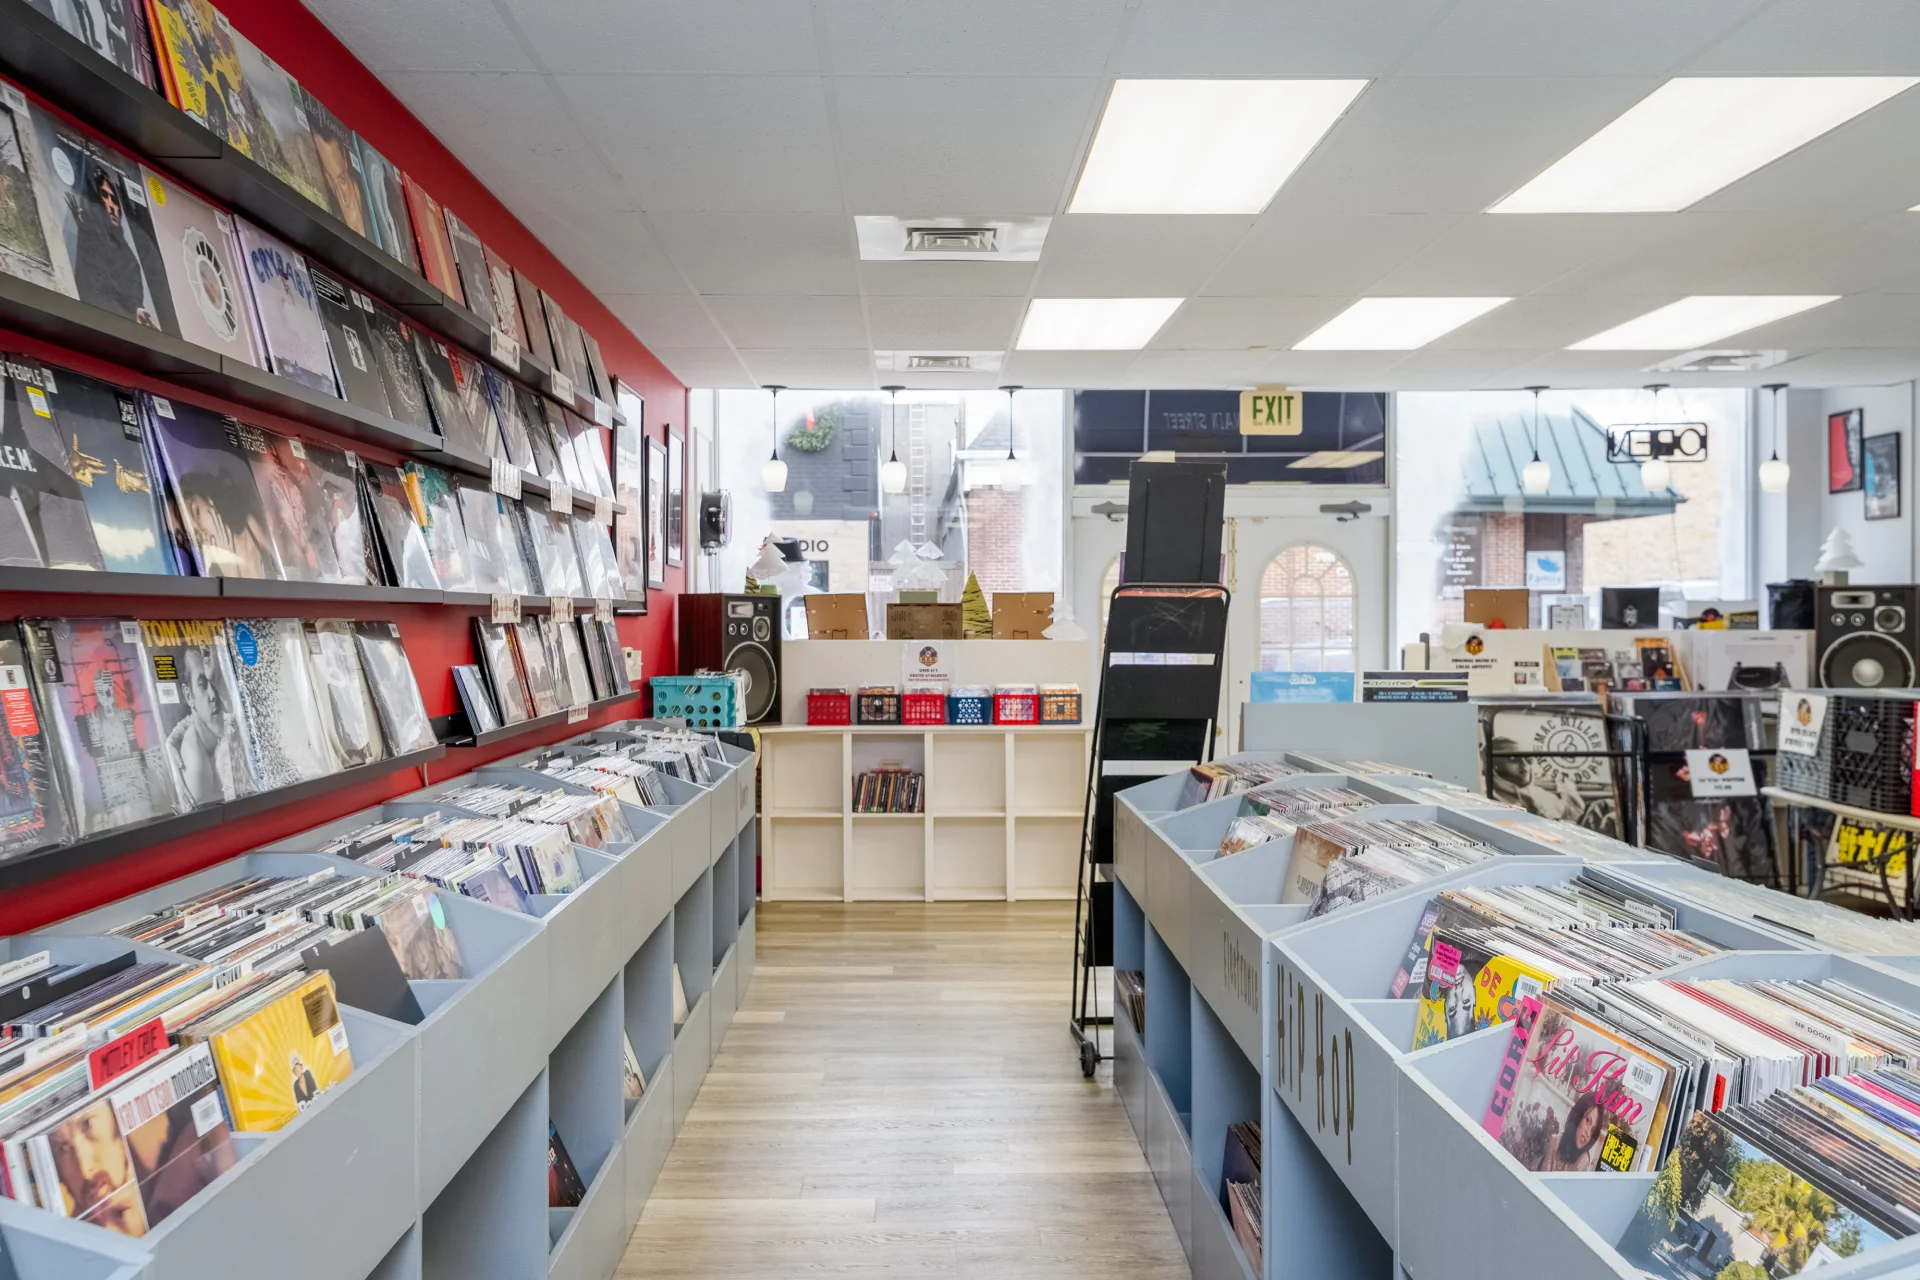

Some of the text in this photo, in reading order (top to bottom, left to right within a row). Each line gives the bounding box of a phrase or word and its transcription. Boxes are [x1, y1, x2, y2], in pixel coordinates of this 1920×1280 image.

[5, 361, 44, 387] PEOPLE
[1252, 395, 1294, 426] EXIT
[0, 445, 37, 472] .E.M.
[141, 620, 181, 647] TOM
[1534, 715, 1602, 749] MAC MILLER
[1574, 756, 1603, 784] DOPE
[1523, 906, 1553, 921] BEASTIE BOYS
[1628, 903, 1644, 914] DEATH
[1480, 966, 1502, 998] DE
[1667, 1020, 1708, 1047] MAC MILLER
[1794, 1020, 1832, 1042] MF DOOM
[1277, 963, 1355, 1166] Hip Hop
[1490, 1005, 1537, 1118] CORE
[171, 1054, 216, 1101] moondance
[1525, 1028, 1581, 1079] Lil'
[1572, 1050, 1648, 1126] Kim
